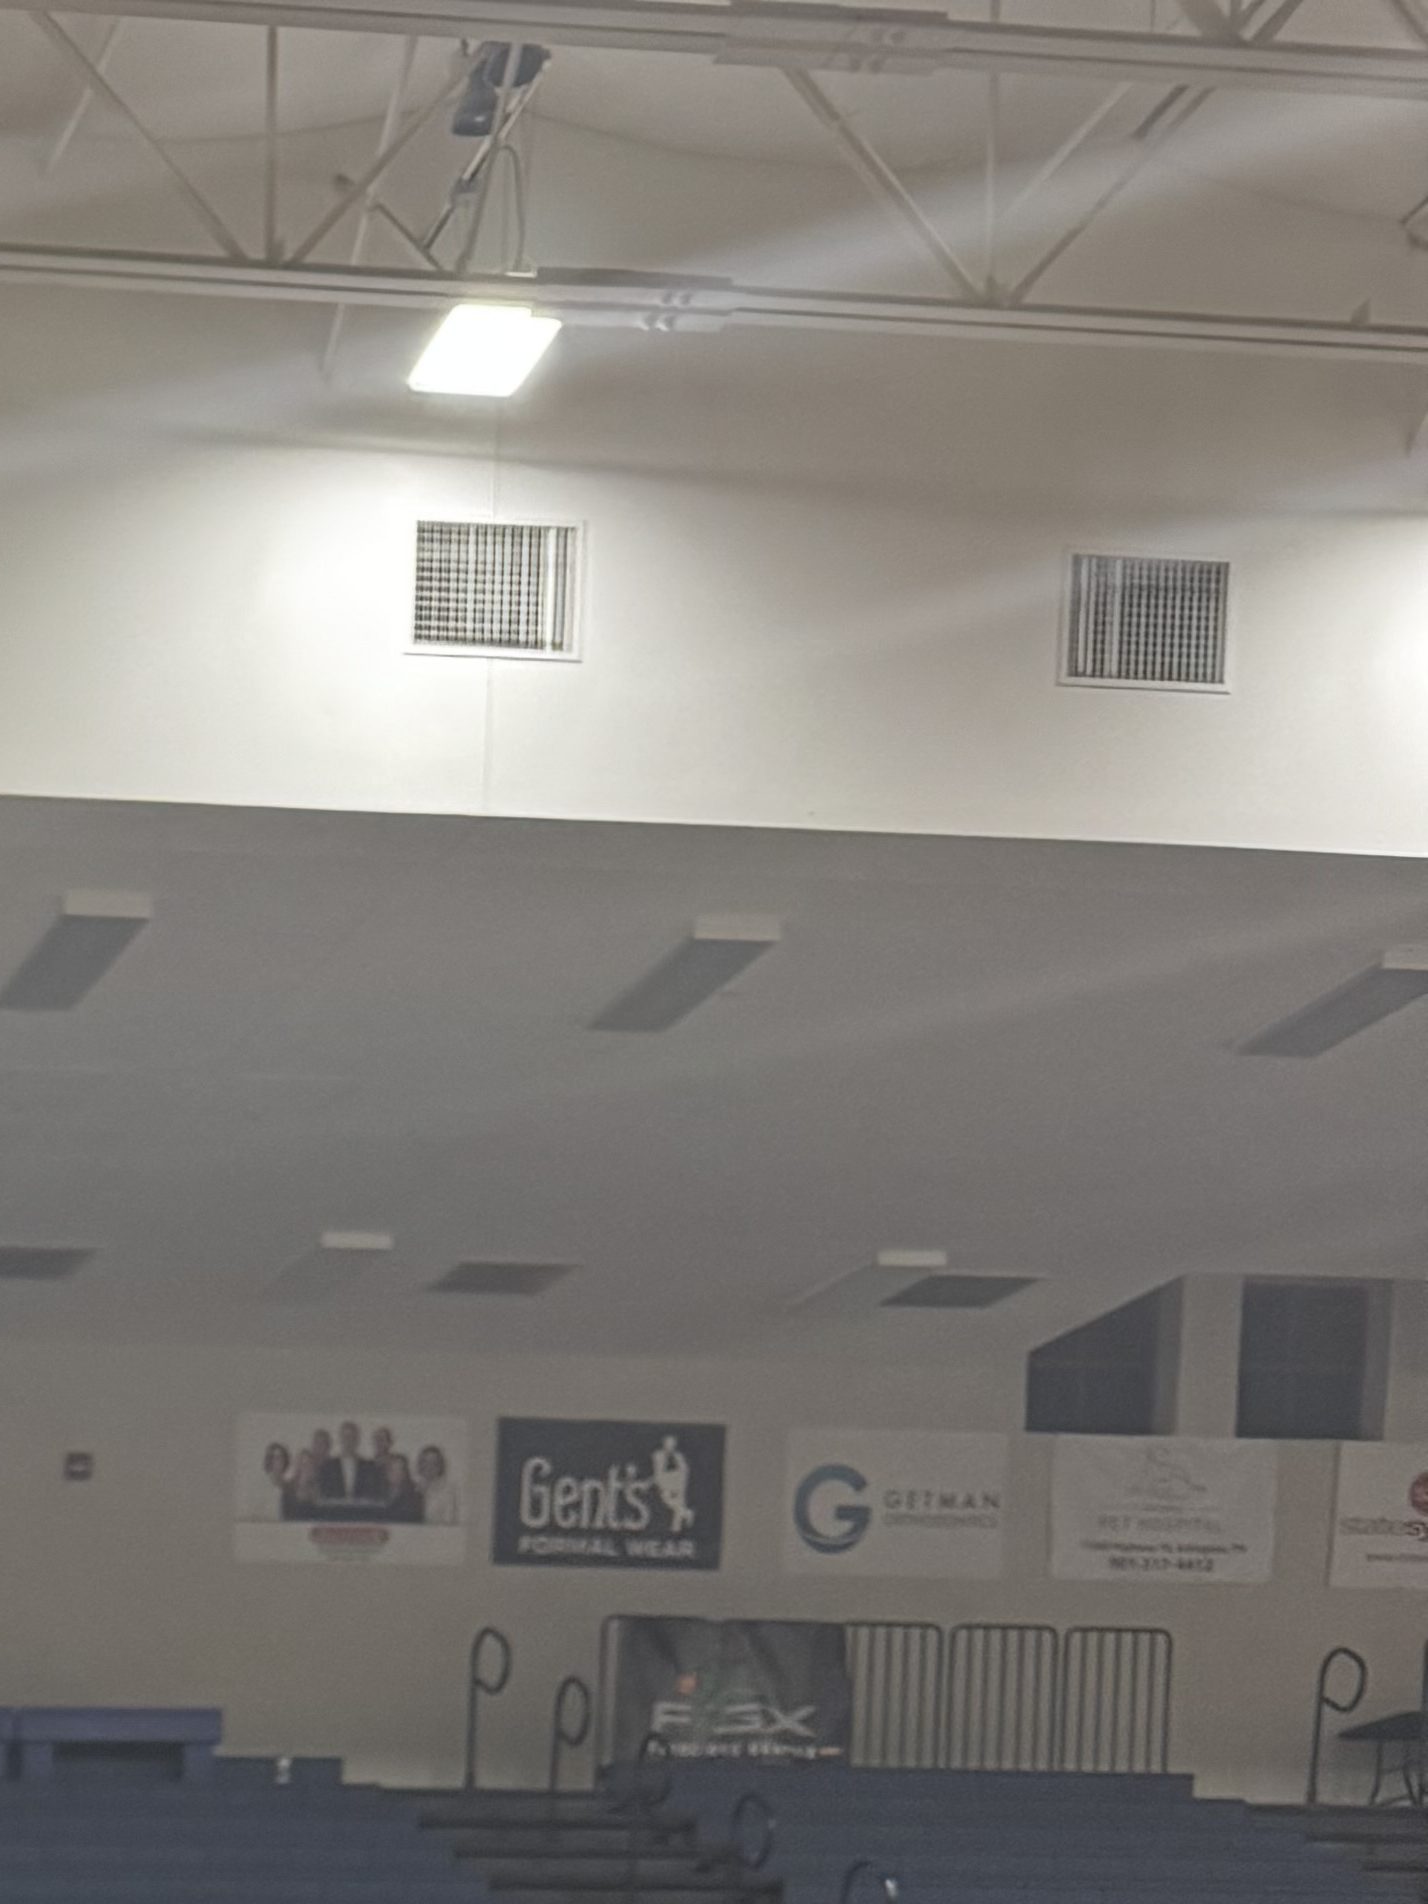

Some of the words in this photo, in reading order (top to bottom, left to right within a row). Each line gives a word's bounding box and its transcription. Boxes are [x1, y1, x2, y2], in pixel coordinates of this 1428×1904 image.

[520, 1456, 651, 1530] Gent's
[882, 1489, 1000, 1509] GETMAN
[518, 1535, 618, 1556] FORMAL
[624, 1538, 694, 1558] WEAR
